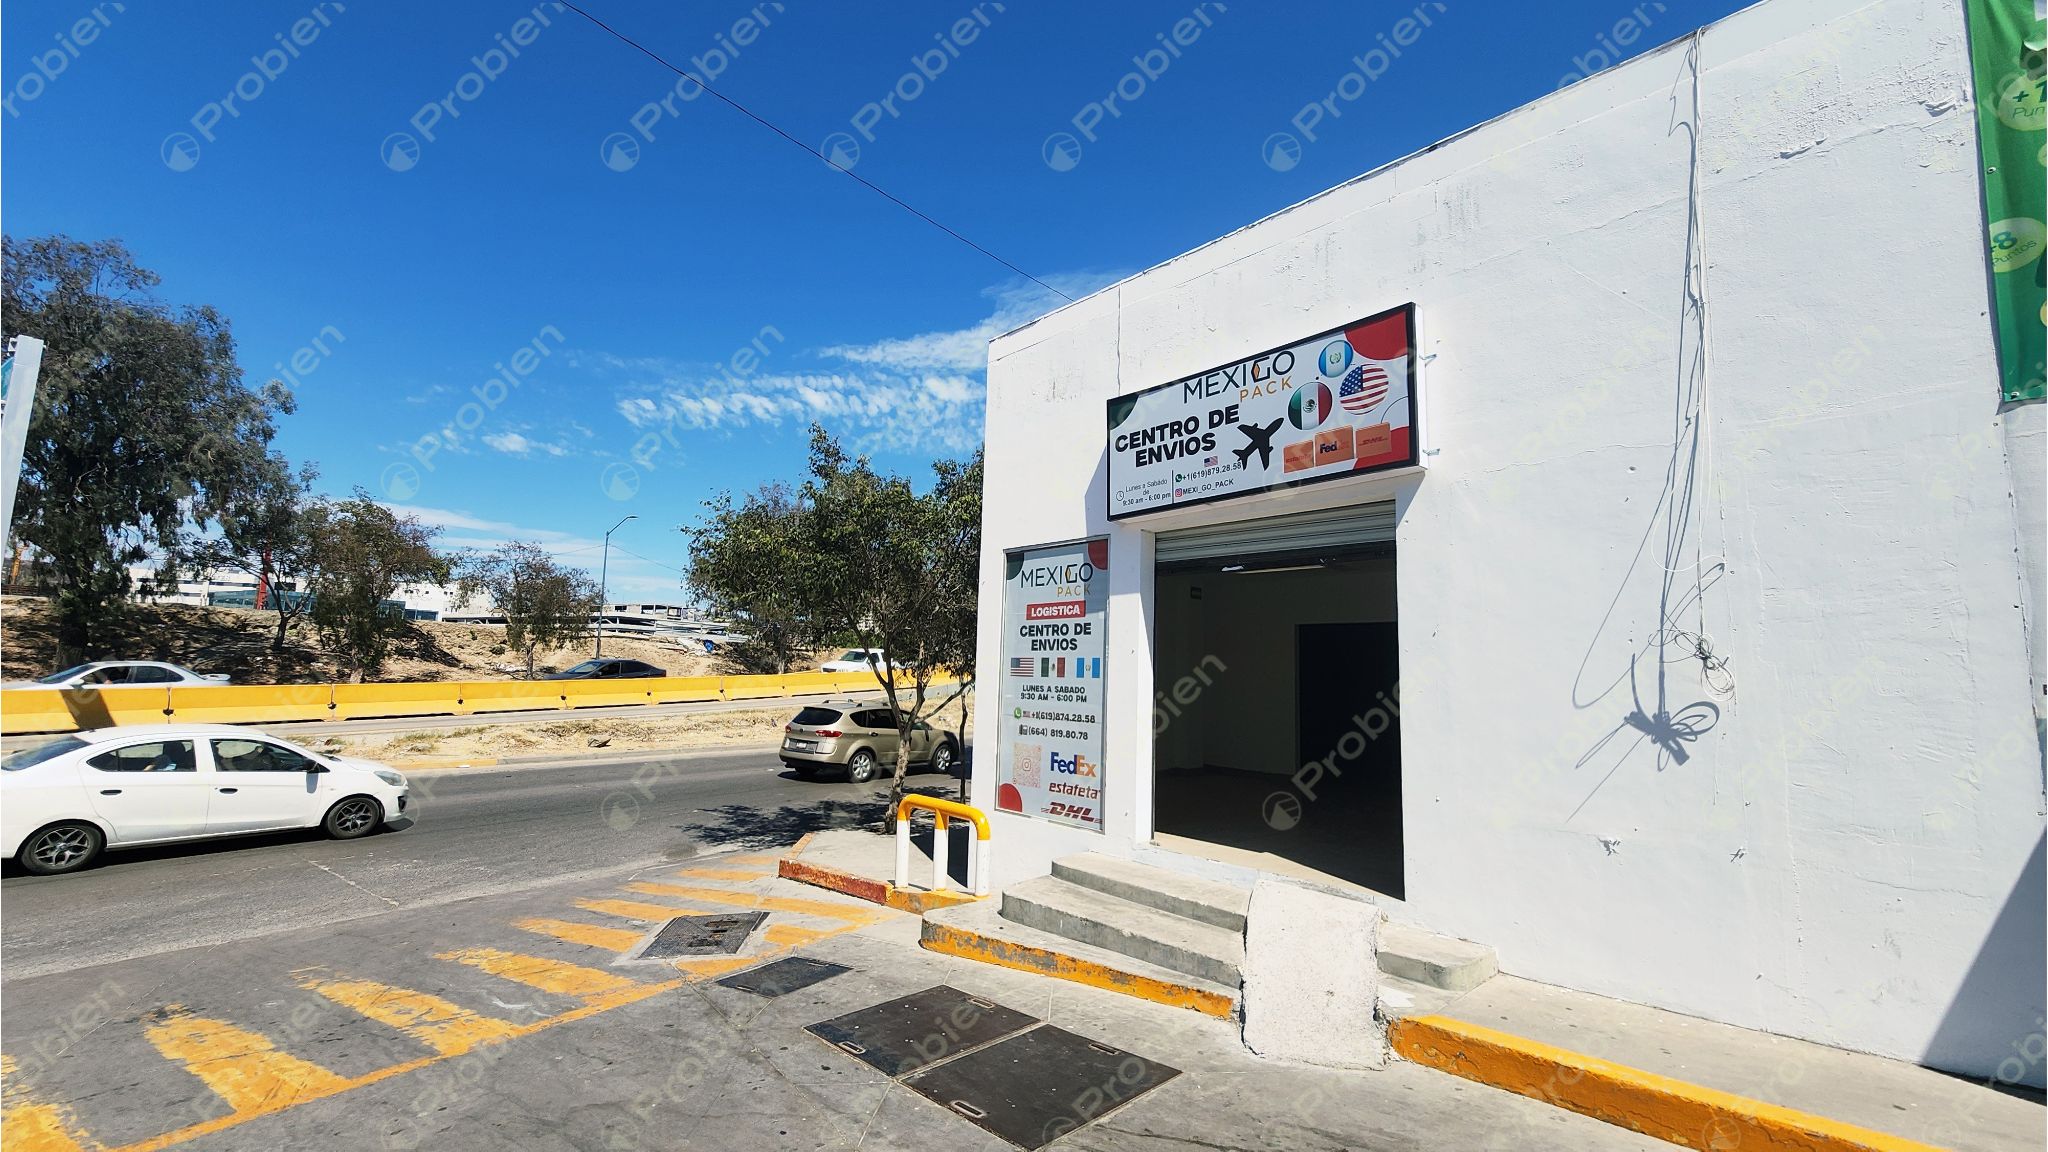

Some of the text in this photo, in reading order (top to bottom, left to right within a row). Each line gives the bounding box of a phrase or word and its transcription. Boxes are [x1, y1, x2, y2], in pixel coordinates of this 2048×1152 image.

[1239, 375, 1293, 402] PACK
[1114, 404, 1240, 452] CENTRO DE
[1135, 432, 1217, 468] ENVIOS
[1125, 483, 1142, 493] Lunes
[1161, 492, 1171, 500] pm
[1057, 584, 1091, 598] PACK
[1031, 604, 1081, 617] LOGISTICA
[1020, 622, 1092, 637] CENTRO DE
[1031, 638, 1078, 652] ENVIOS
[1022, 684, 1044, 692] LUNES
[1054, 685, 1086, 694] SABADO
[1020, 692, 1035, 700] 9:30
[1056, 694, 1073, 702] 6:00
[1028, 726, 1088, 741] (664) 819.80.78
[1050, 751, 1096, 777] FedEx
[1049, 782, 1098, 799] estafeta
[1049, 801, 1095, 822] DHL
